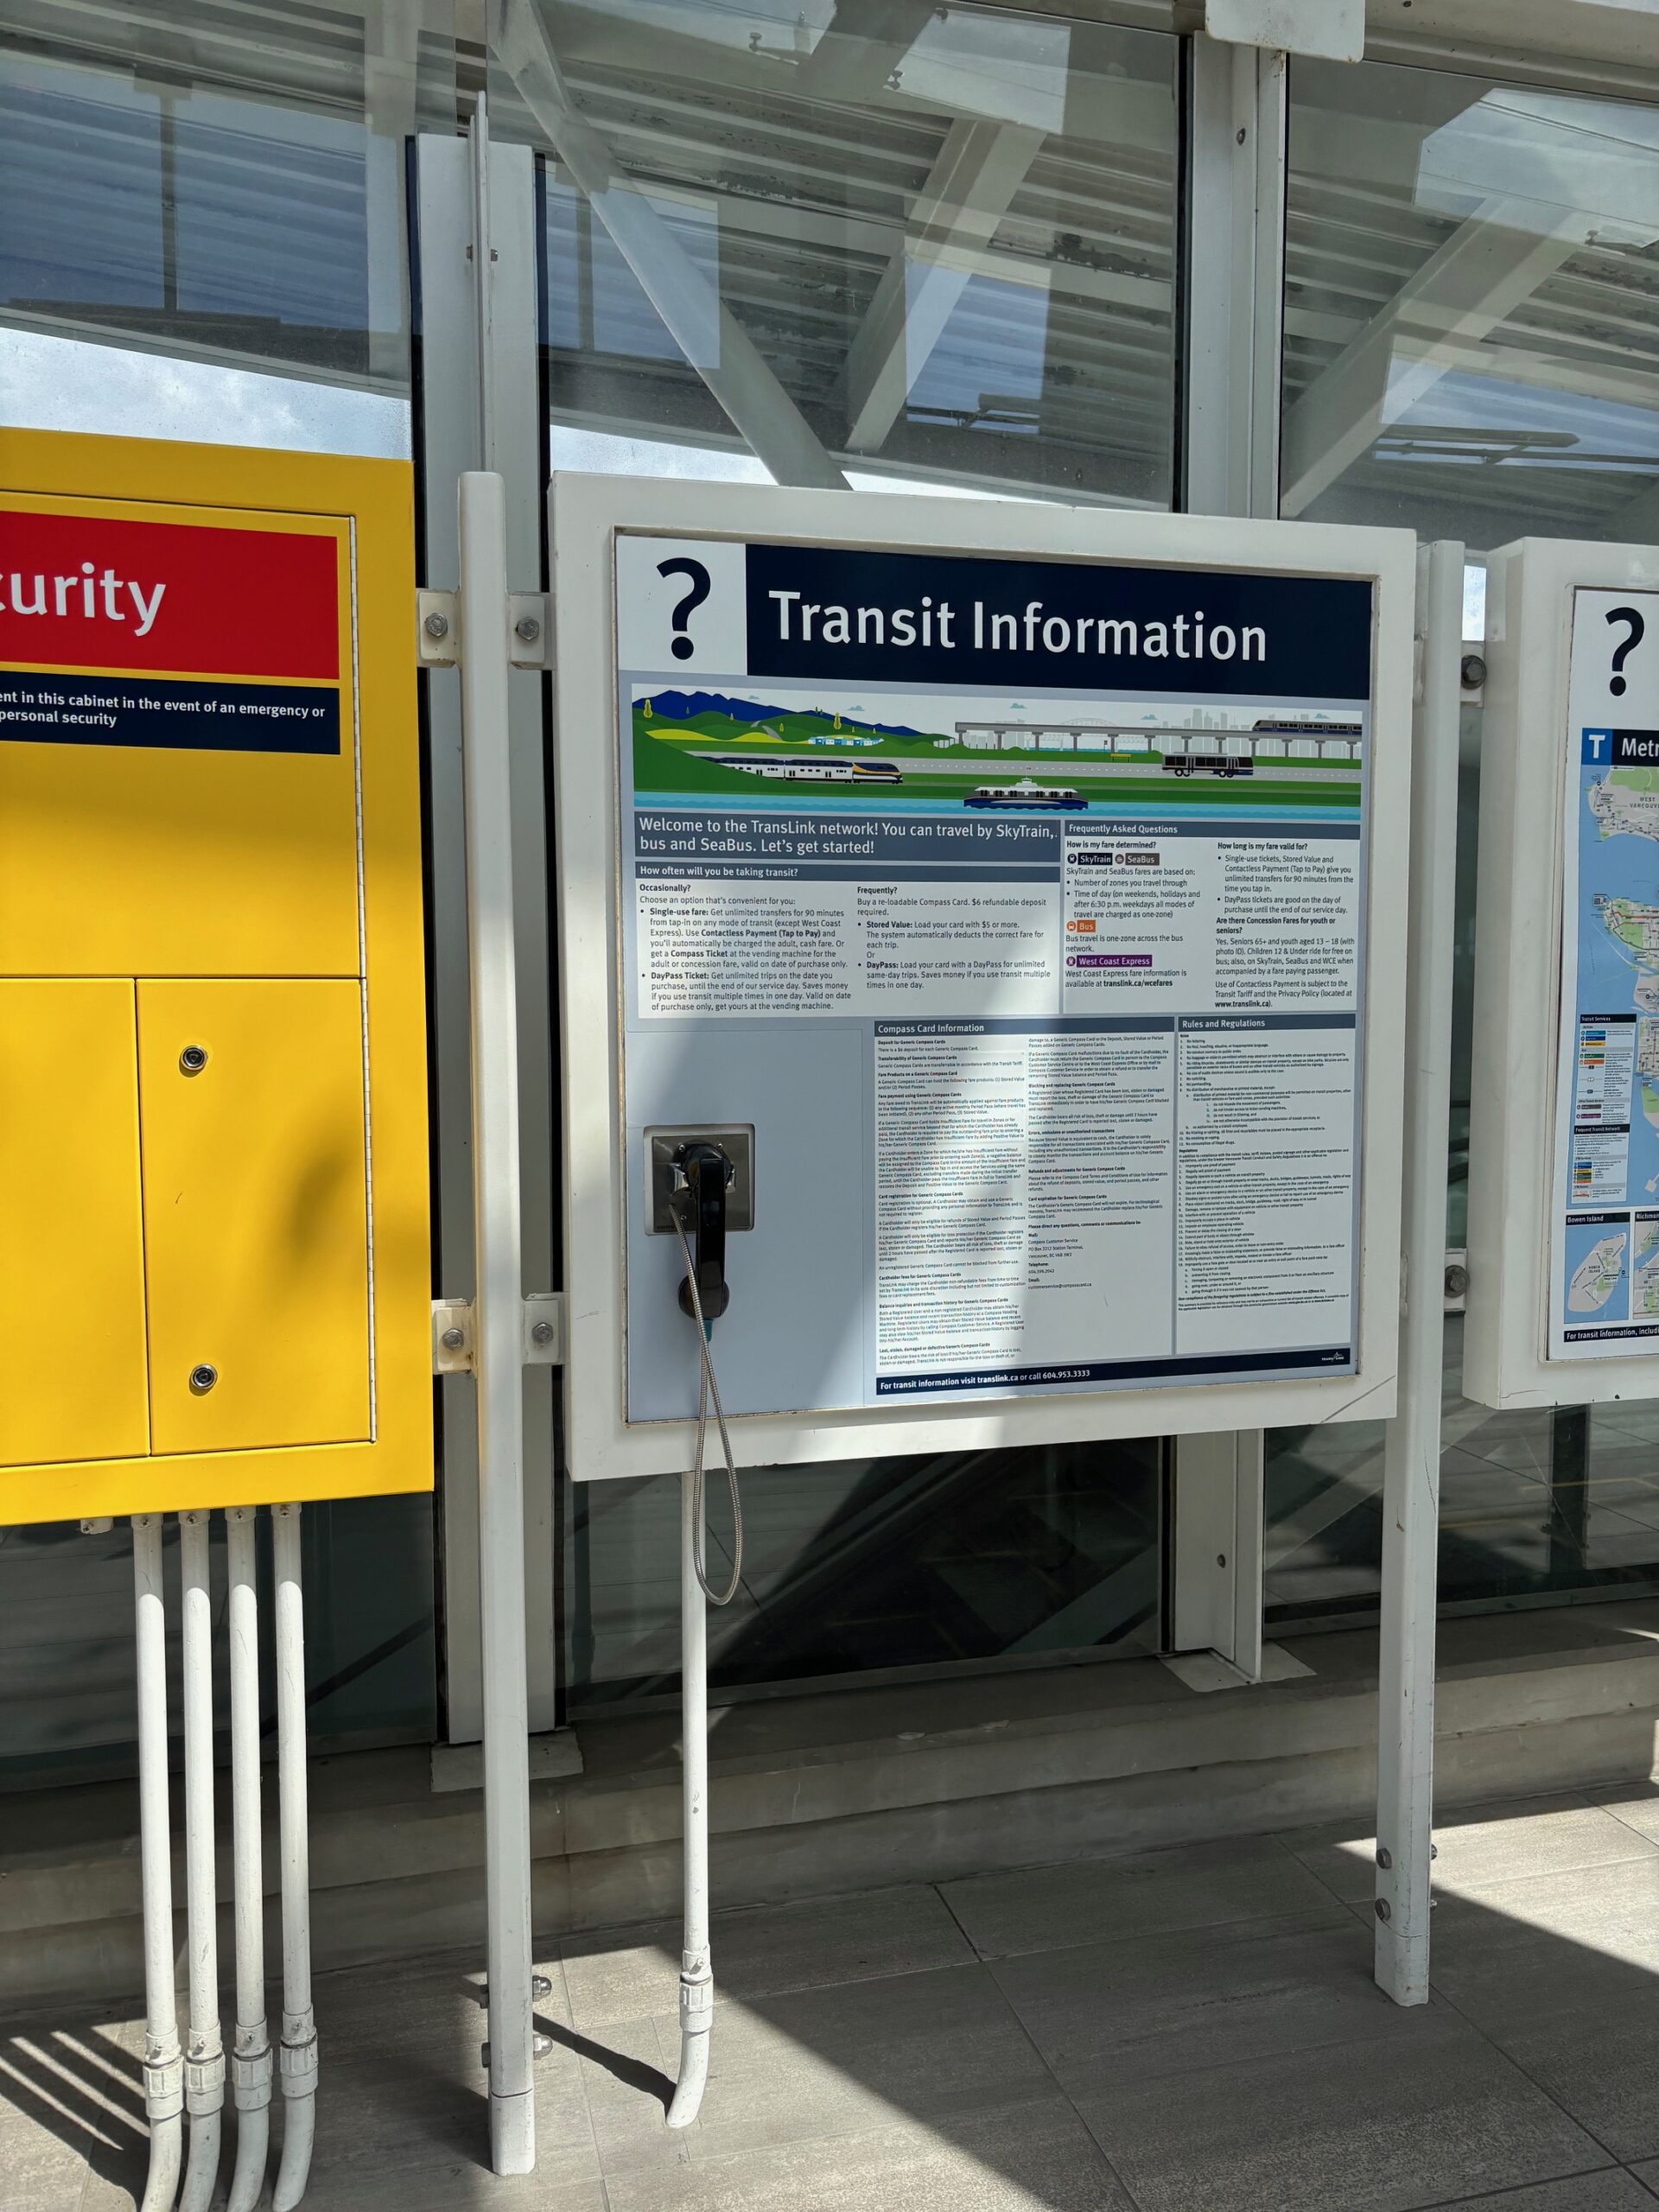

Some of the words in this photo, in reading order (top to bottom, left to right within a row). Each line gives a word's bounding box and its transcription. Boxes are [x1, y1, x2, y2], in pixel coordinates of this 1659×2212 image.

[0, 562, 166, 637] urity
[656, 557, 710, 659] ?
[769, 589, 955, 648] Transit
[975, 599, 1265, 662] Information
[22, 692, 34, 702] in
[38, 692, 65, 704] this
[68, 694, 118, 708] cabinet
[123, 696, 135, 708] in
[138, 697, 161, 709] the
[164, 700, 200, 711] event
[203, 700, 217, 712] of
[219, 704, 235, 713] an
[238, 704, 308, 718] emergency
[311, 708, 325, 716] or
[62, 713, 117, 728] security
[1588, 734, 1605, 758] T
[639, 817, 702, 831] Welcome
[707, 820, 721, 832] to
[725, 819, 747, 832] the
[750, 820, 816, 834] TransLink
[820, 821, 878, 835] network!
[881, 823, 906, 836] You
[910, 826, 931, 836] can
[936, 823, 973, 836] travel
[977, 823, 992, 838] by
[1069, 823, 1110, 834] Frequently
[1138, 824, 1177, 834] Questions
[640, 836, 666, 849] bus
[670, 836, 696, 850] and
[701, 837, 756, 851] SeaBus.
[797, 840, 818, 855] get
[823, 840, 874, 853] started!
[1080, 855, 1110, 865] SkyTrain
[640, 866, 660, 874] How
[661, 866, 684, 874] often
[704, 868, 721, 877] you
[723, 867, 734, 875] be
[735, 867, 764, 878] taking
[765, 868, 798, 876] transit?
[639, 883, 690, 893] Occasionally?
[857, 887, 897, 895] Frequently?
[680, 896, 703, 905] option
[857, 898, 871, 906] Buy
[918, 898, 950, 906] Compass
[1020, 898, 1046, 906] deposit
[650, 907, 690, 917] Single-use
[745, 929, 777, 938] Payment
[779, 929, 794, 938] (Tap
[804, 929, 820, 938] Pay)
[1121, 957, 1149, 967] Express
[1103, 979, 1173, 988] translink.ca/wcefares
[878, 1025, 915, 1034] Compass
[938, 1023, 984, 1032] Information
[1221, 1020, 1265, 1028] Regulations
[893, 1380, 917, 1389] transit
[918, 1377, 959, 1387] information
[960, 1376, 976, 1384] visit
[976, 1373, 1018, 1382] translink.ca
[1042, 1370, 1090, 1378] 604.953.3333
